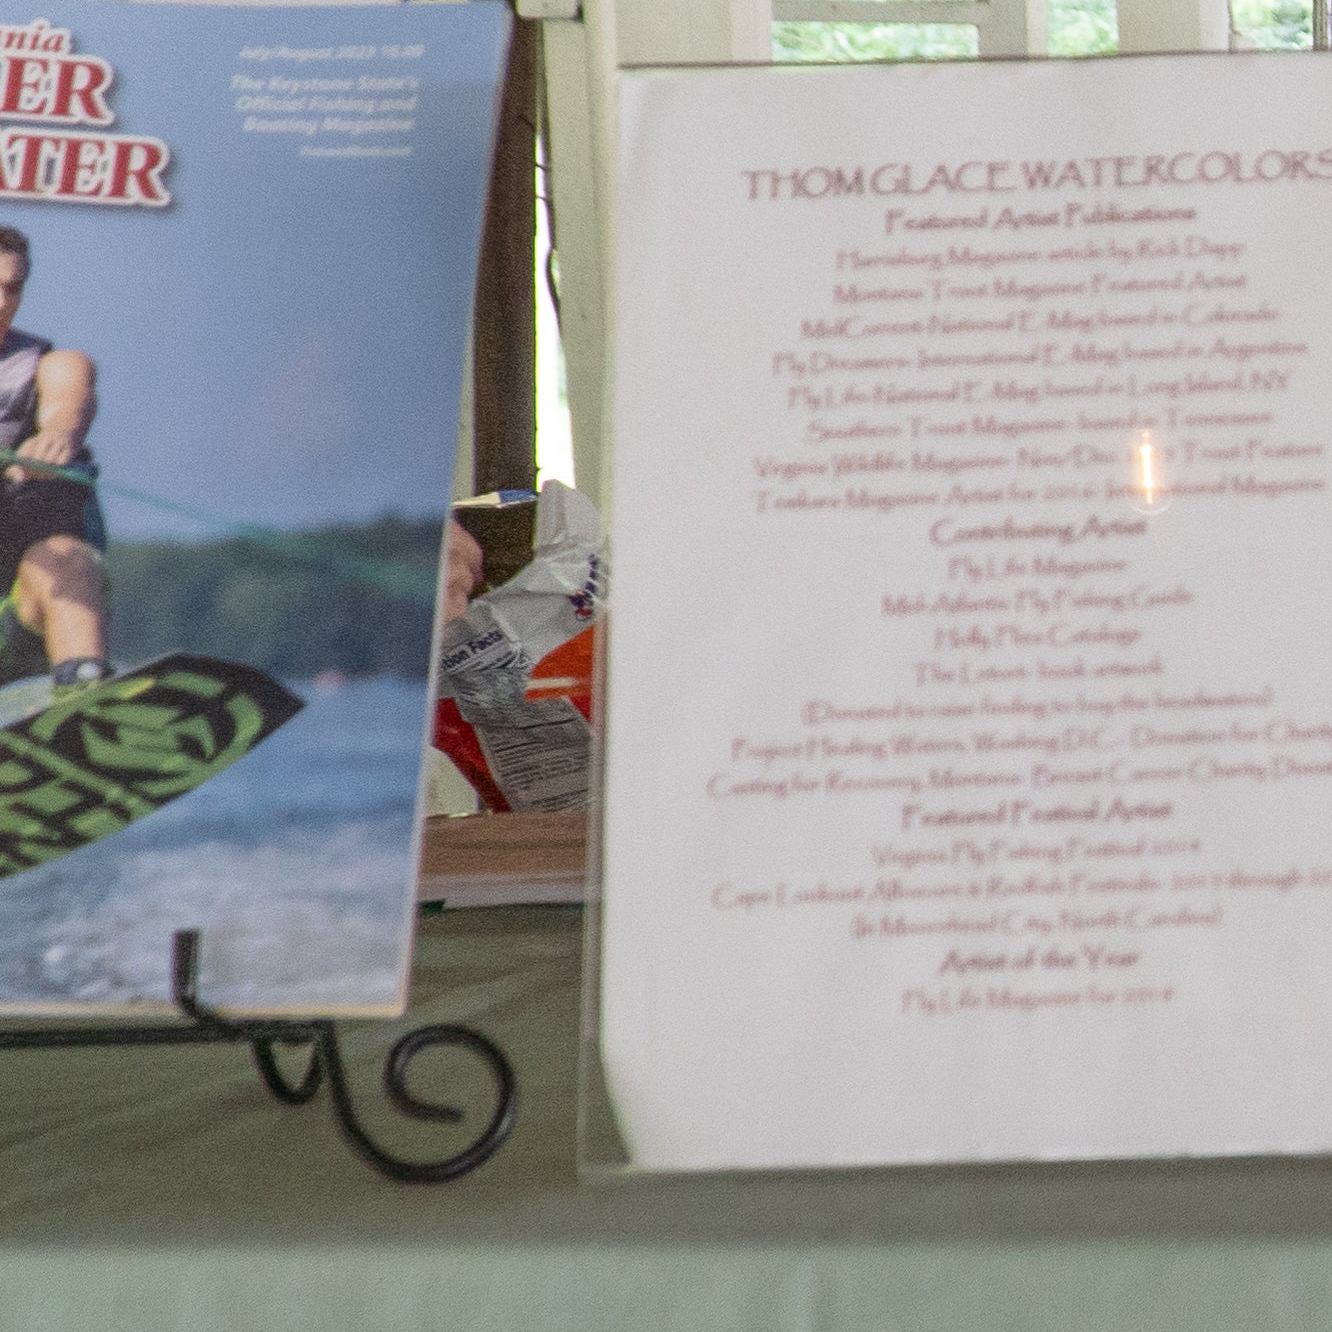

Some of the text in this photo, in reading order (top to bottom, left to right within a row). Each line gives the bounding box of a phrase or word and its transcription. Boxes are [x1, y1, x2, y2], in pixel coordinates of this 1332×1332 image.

[0, 24, 64, 53] nia
[0, 134, 162, 201] TER
[740, 166, 864, 201] THOM
[869, 160, 1017, 197] GLACE
[884, 202, 1197, 235] Featured Artist Publications
[928, 516, 1075, 547] Contributing
[903, 803, 1008, 831] Featured
